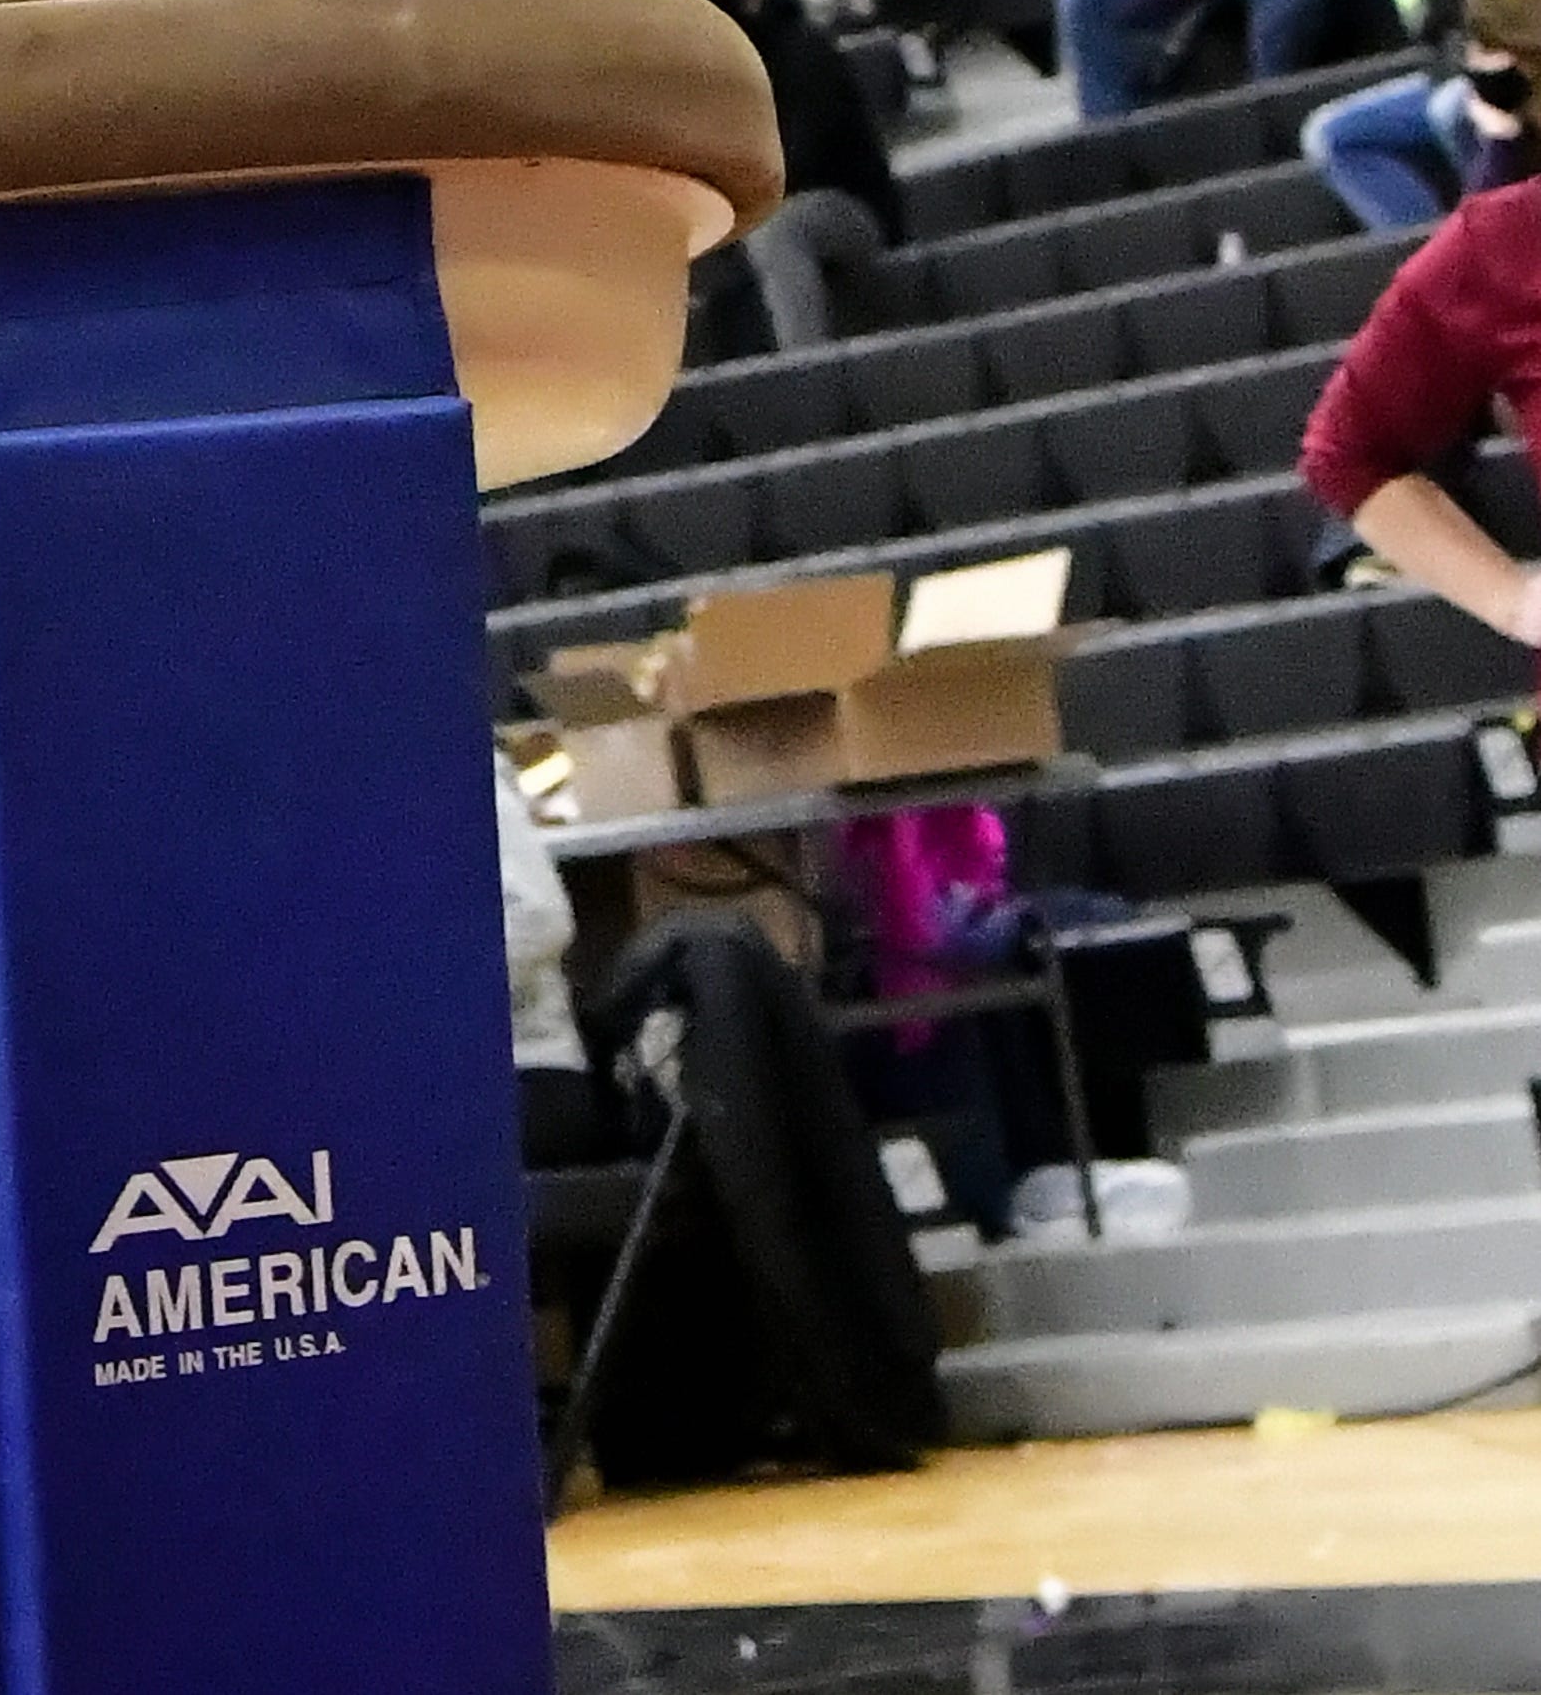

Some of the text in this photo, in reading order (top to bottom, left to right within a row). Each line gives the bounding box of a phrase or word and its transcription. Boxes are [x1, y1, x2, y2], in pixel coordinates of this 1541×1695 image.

[94, 1355, 168, 1387] MADE
[178, 1348, 205, 1375] IN
[211, 1342, 264, 1371] THE
